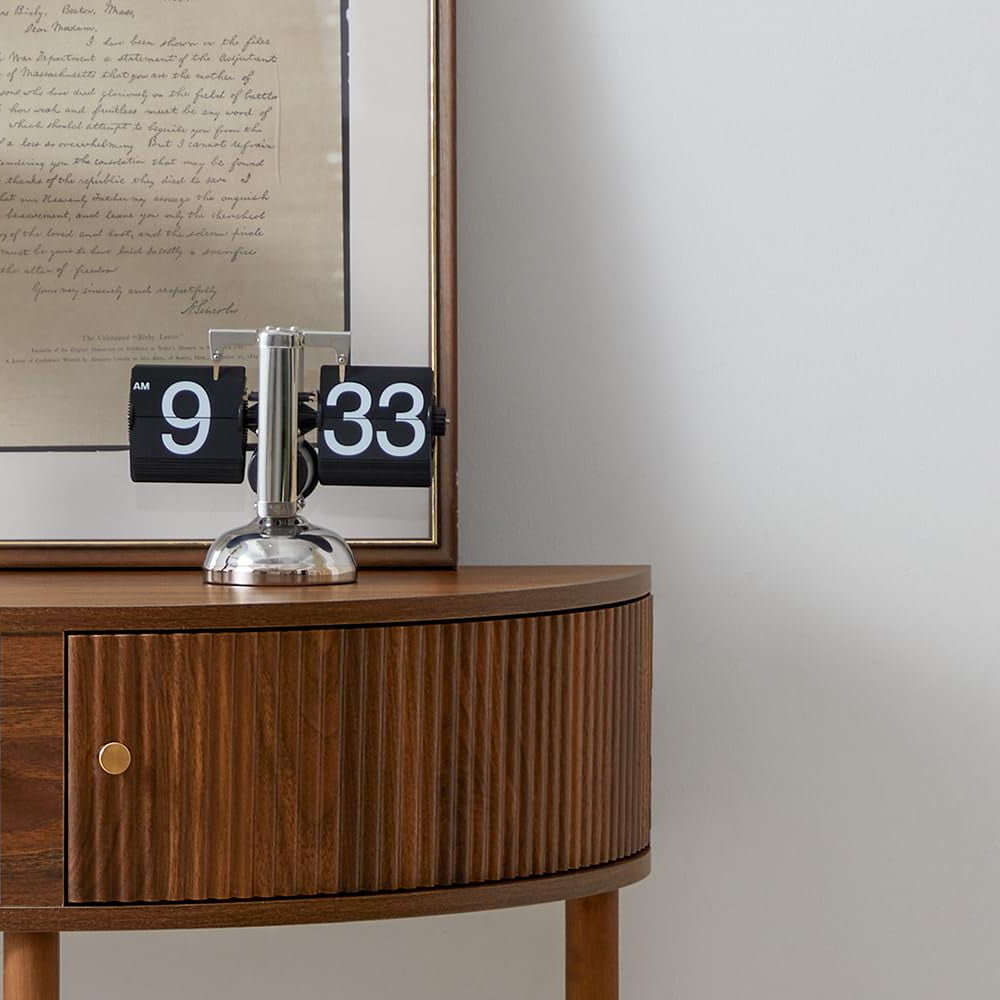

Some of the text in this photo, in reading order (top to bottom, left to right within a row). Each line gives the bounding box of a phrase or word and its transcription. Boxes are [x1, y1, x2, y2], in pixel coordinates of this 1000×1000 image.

[222, 35, 238, 46] the
[133, 382, 150, 391] AM
[161, 381, 212, 456] 9
[323, 381, 427, 457] 33
